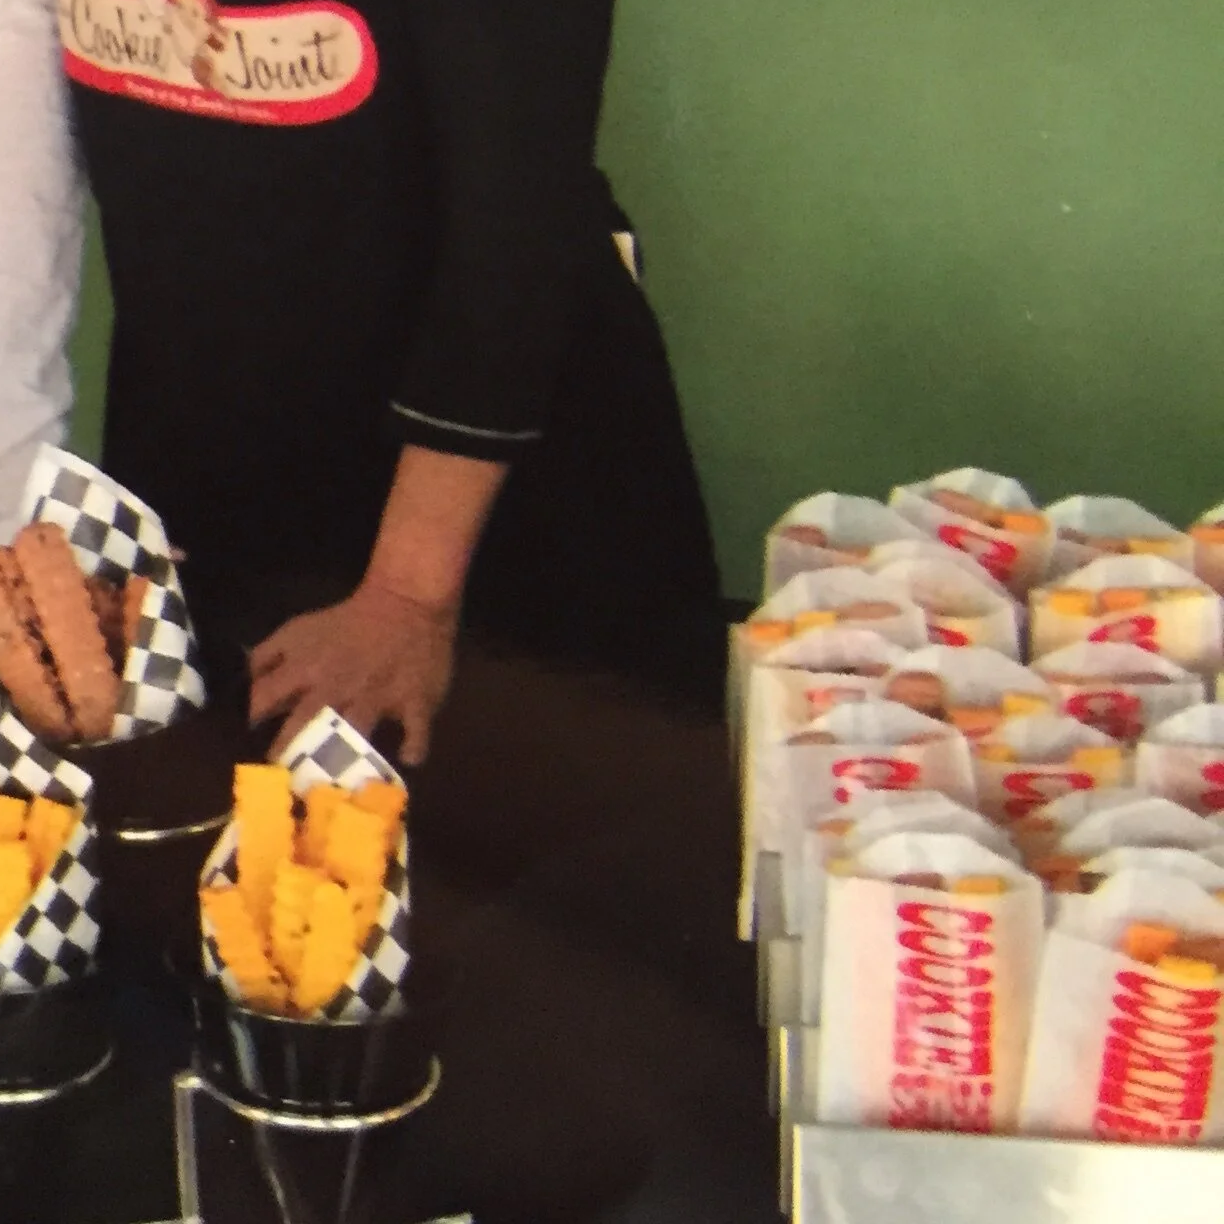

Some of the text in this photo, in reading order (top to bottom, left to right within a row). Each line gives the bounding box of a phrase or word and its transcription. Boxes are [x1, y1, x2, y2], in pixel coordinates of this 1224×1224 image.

[226, 29, 339, 90] Joint
[893, 902, 993, 1076] COOKIE
[1098, 971, 1221, 1122] COOKIE
